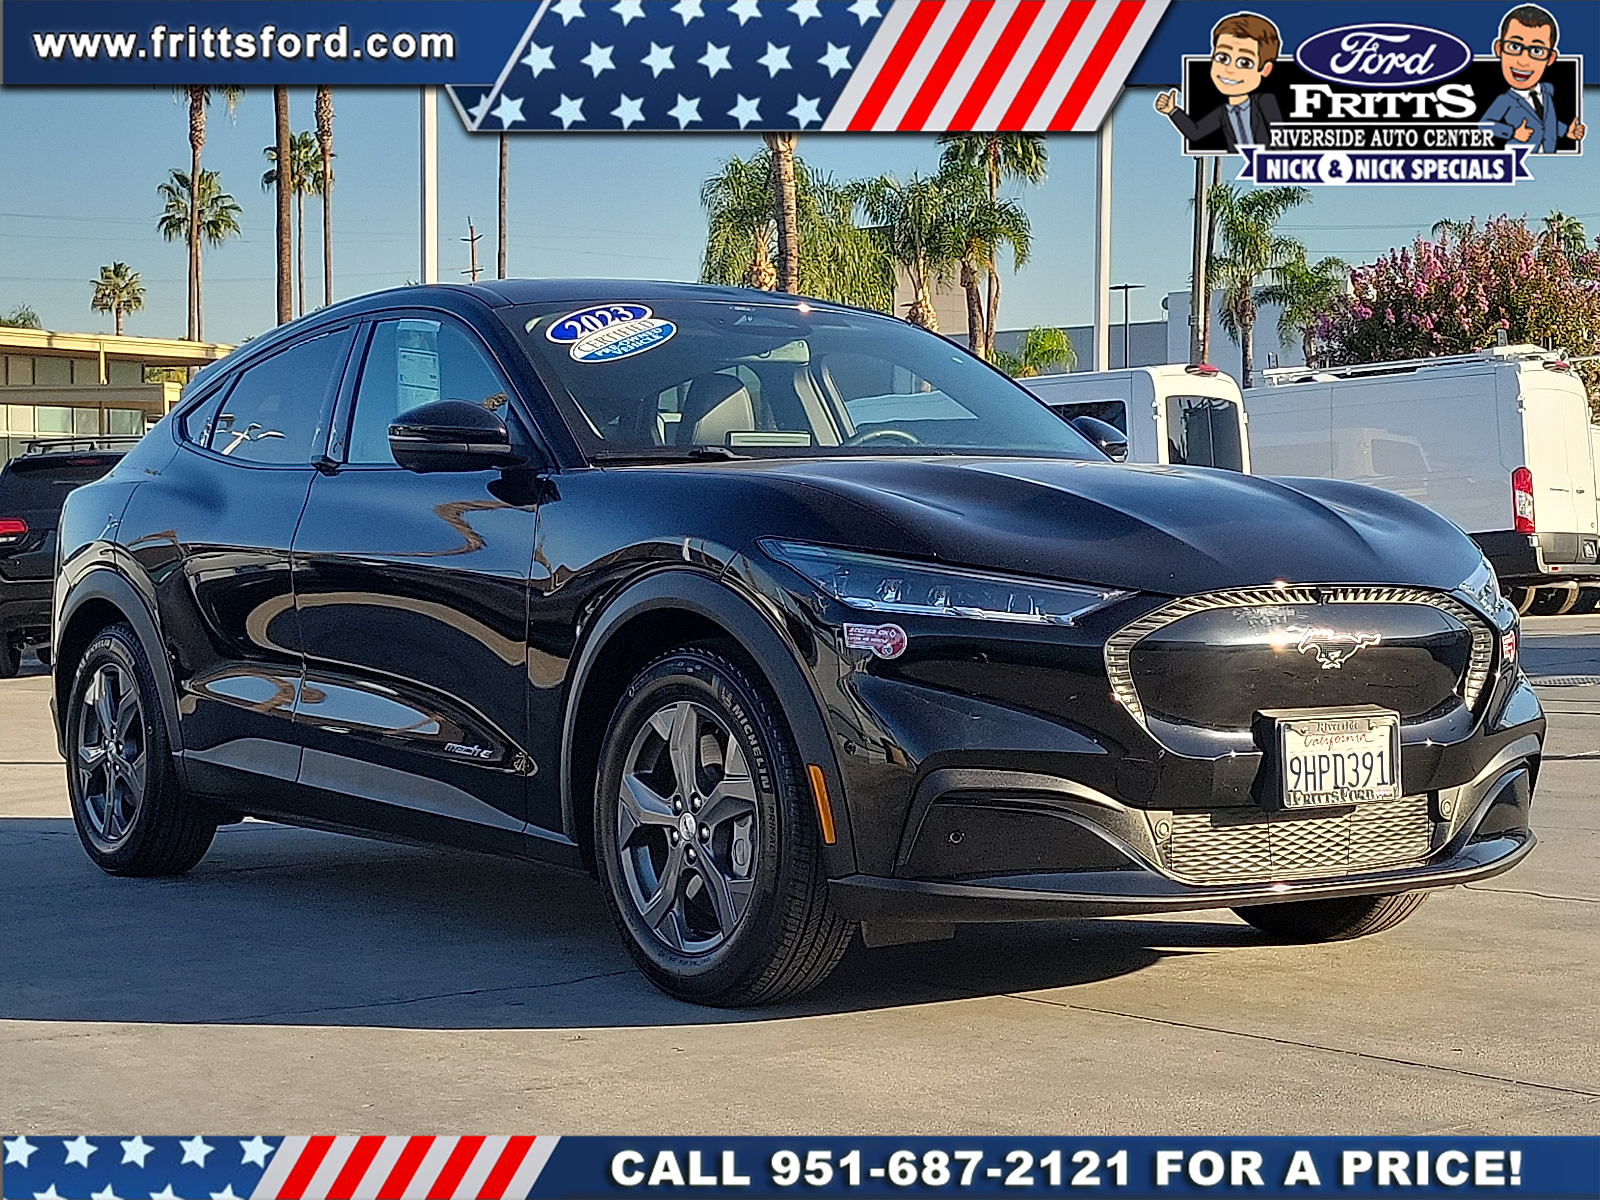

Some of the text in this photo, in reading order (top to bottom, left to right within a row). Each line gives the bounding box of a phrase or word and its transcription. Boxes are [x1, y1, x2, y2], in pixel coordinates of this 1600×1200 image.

[565, 306, 635, 339] 2023
[577, 320, 655, 352] CERTIFIED
[732, 703, 771, 789] MICHELIN
[1304, 733, 1374, 751] California
[1289, 750, 1389, 792] 9HPD391
